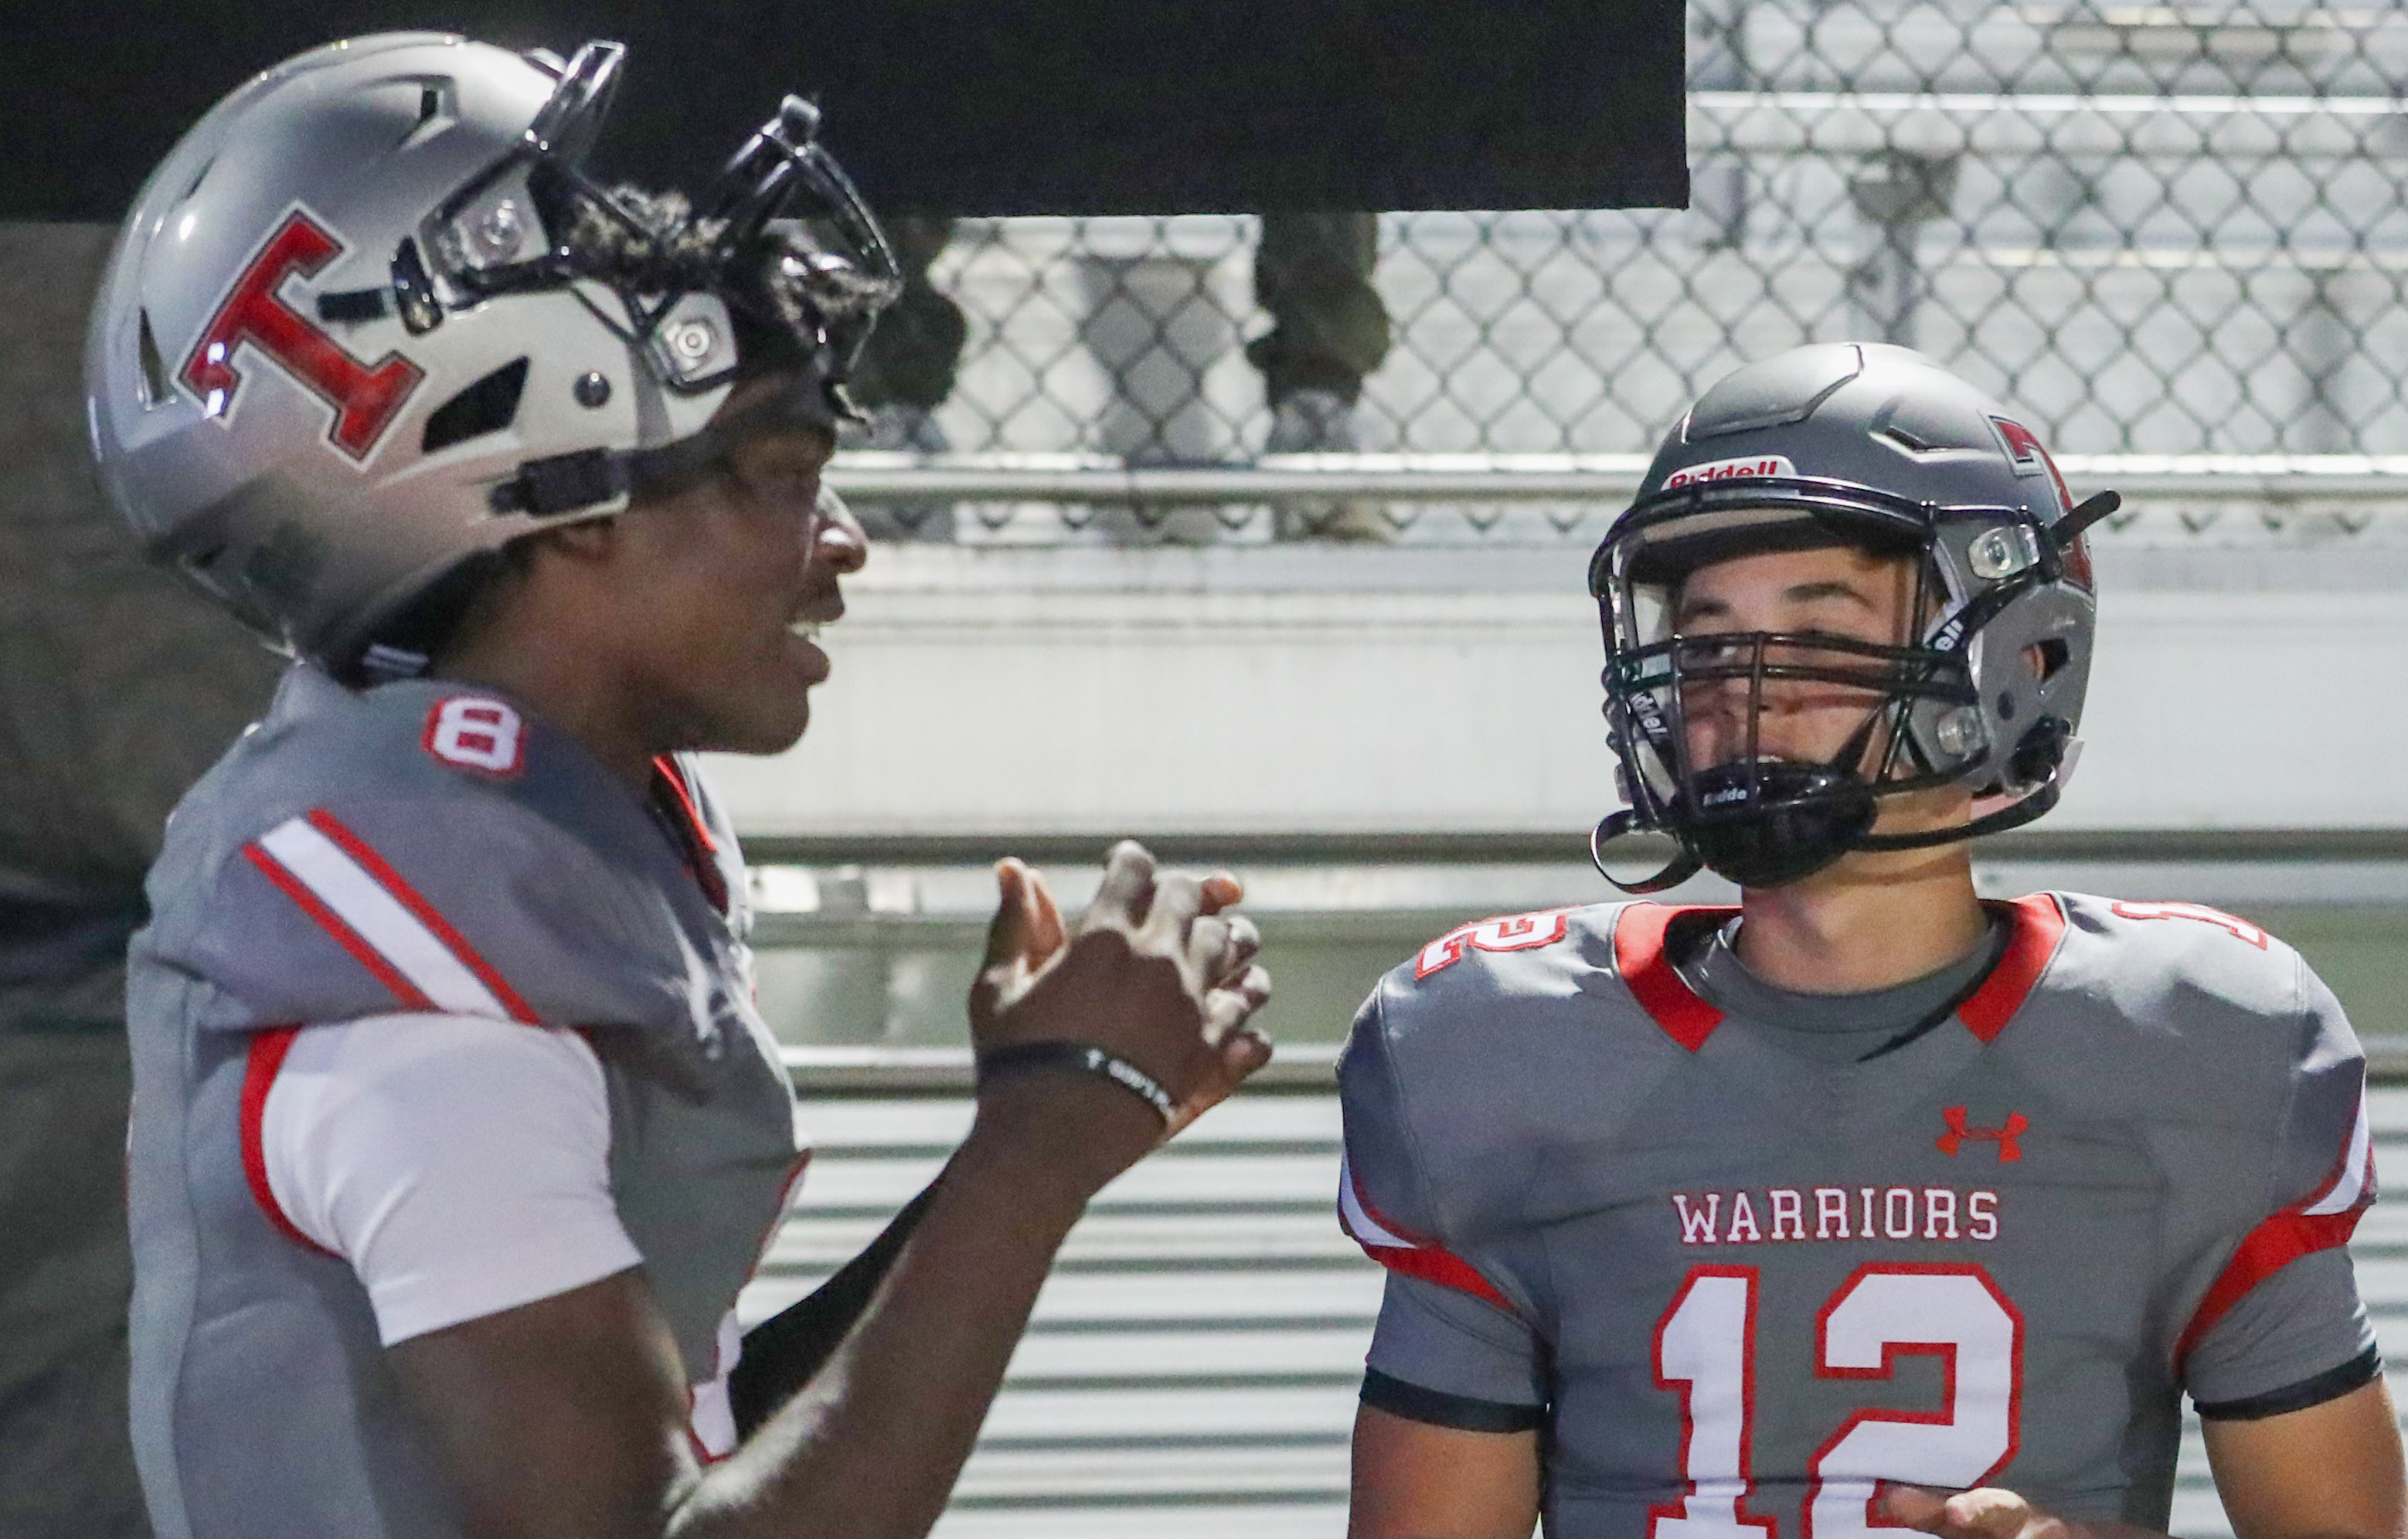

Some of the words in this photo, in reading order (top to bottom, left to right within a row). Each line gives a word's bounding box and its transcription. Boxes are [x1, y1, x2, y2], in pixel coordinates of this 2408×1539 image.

[175, 203, 428, 470] T
[423, 695, 528, 776] 8
[1672, 1187, 2002, 1244] WARRIORS
[1647, 1262, 2025, 1539] 12
